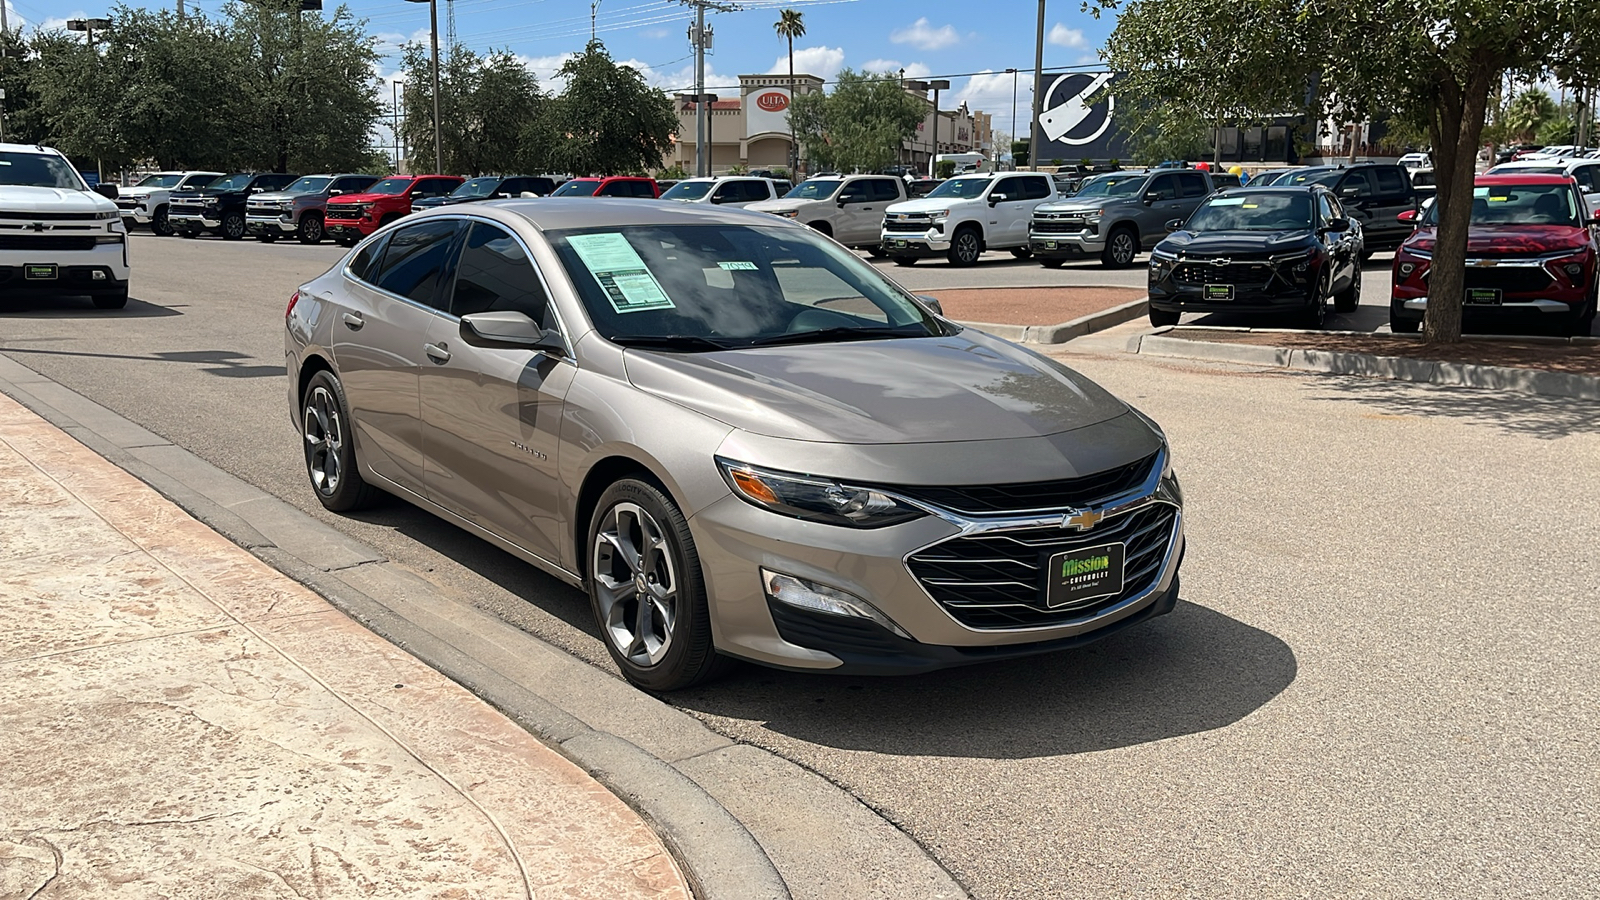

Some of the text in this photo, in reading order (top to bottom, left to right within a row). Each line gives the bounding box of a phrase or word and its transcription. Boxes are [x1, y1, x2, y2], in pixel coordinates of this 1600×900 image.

[762, 96, 785, 105] ULTA
[1062, 555, 1109, 577] Mission
[1070, 571, 1108, 584] CHEVROLET
